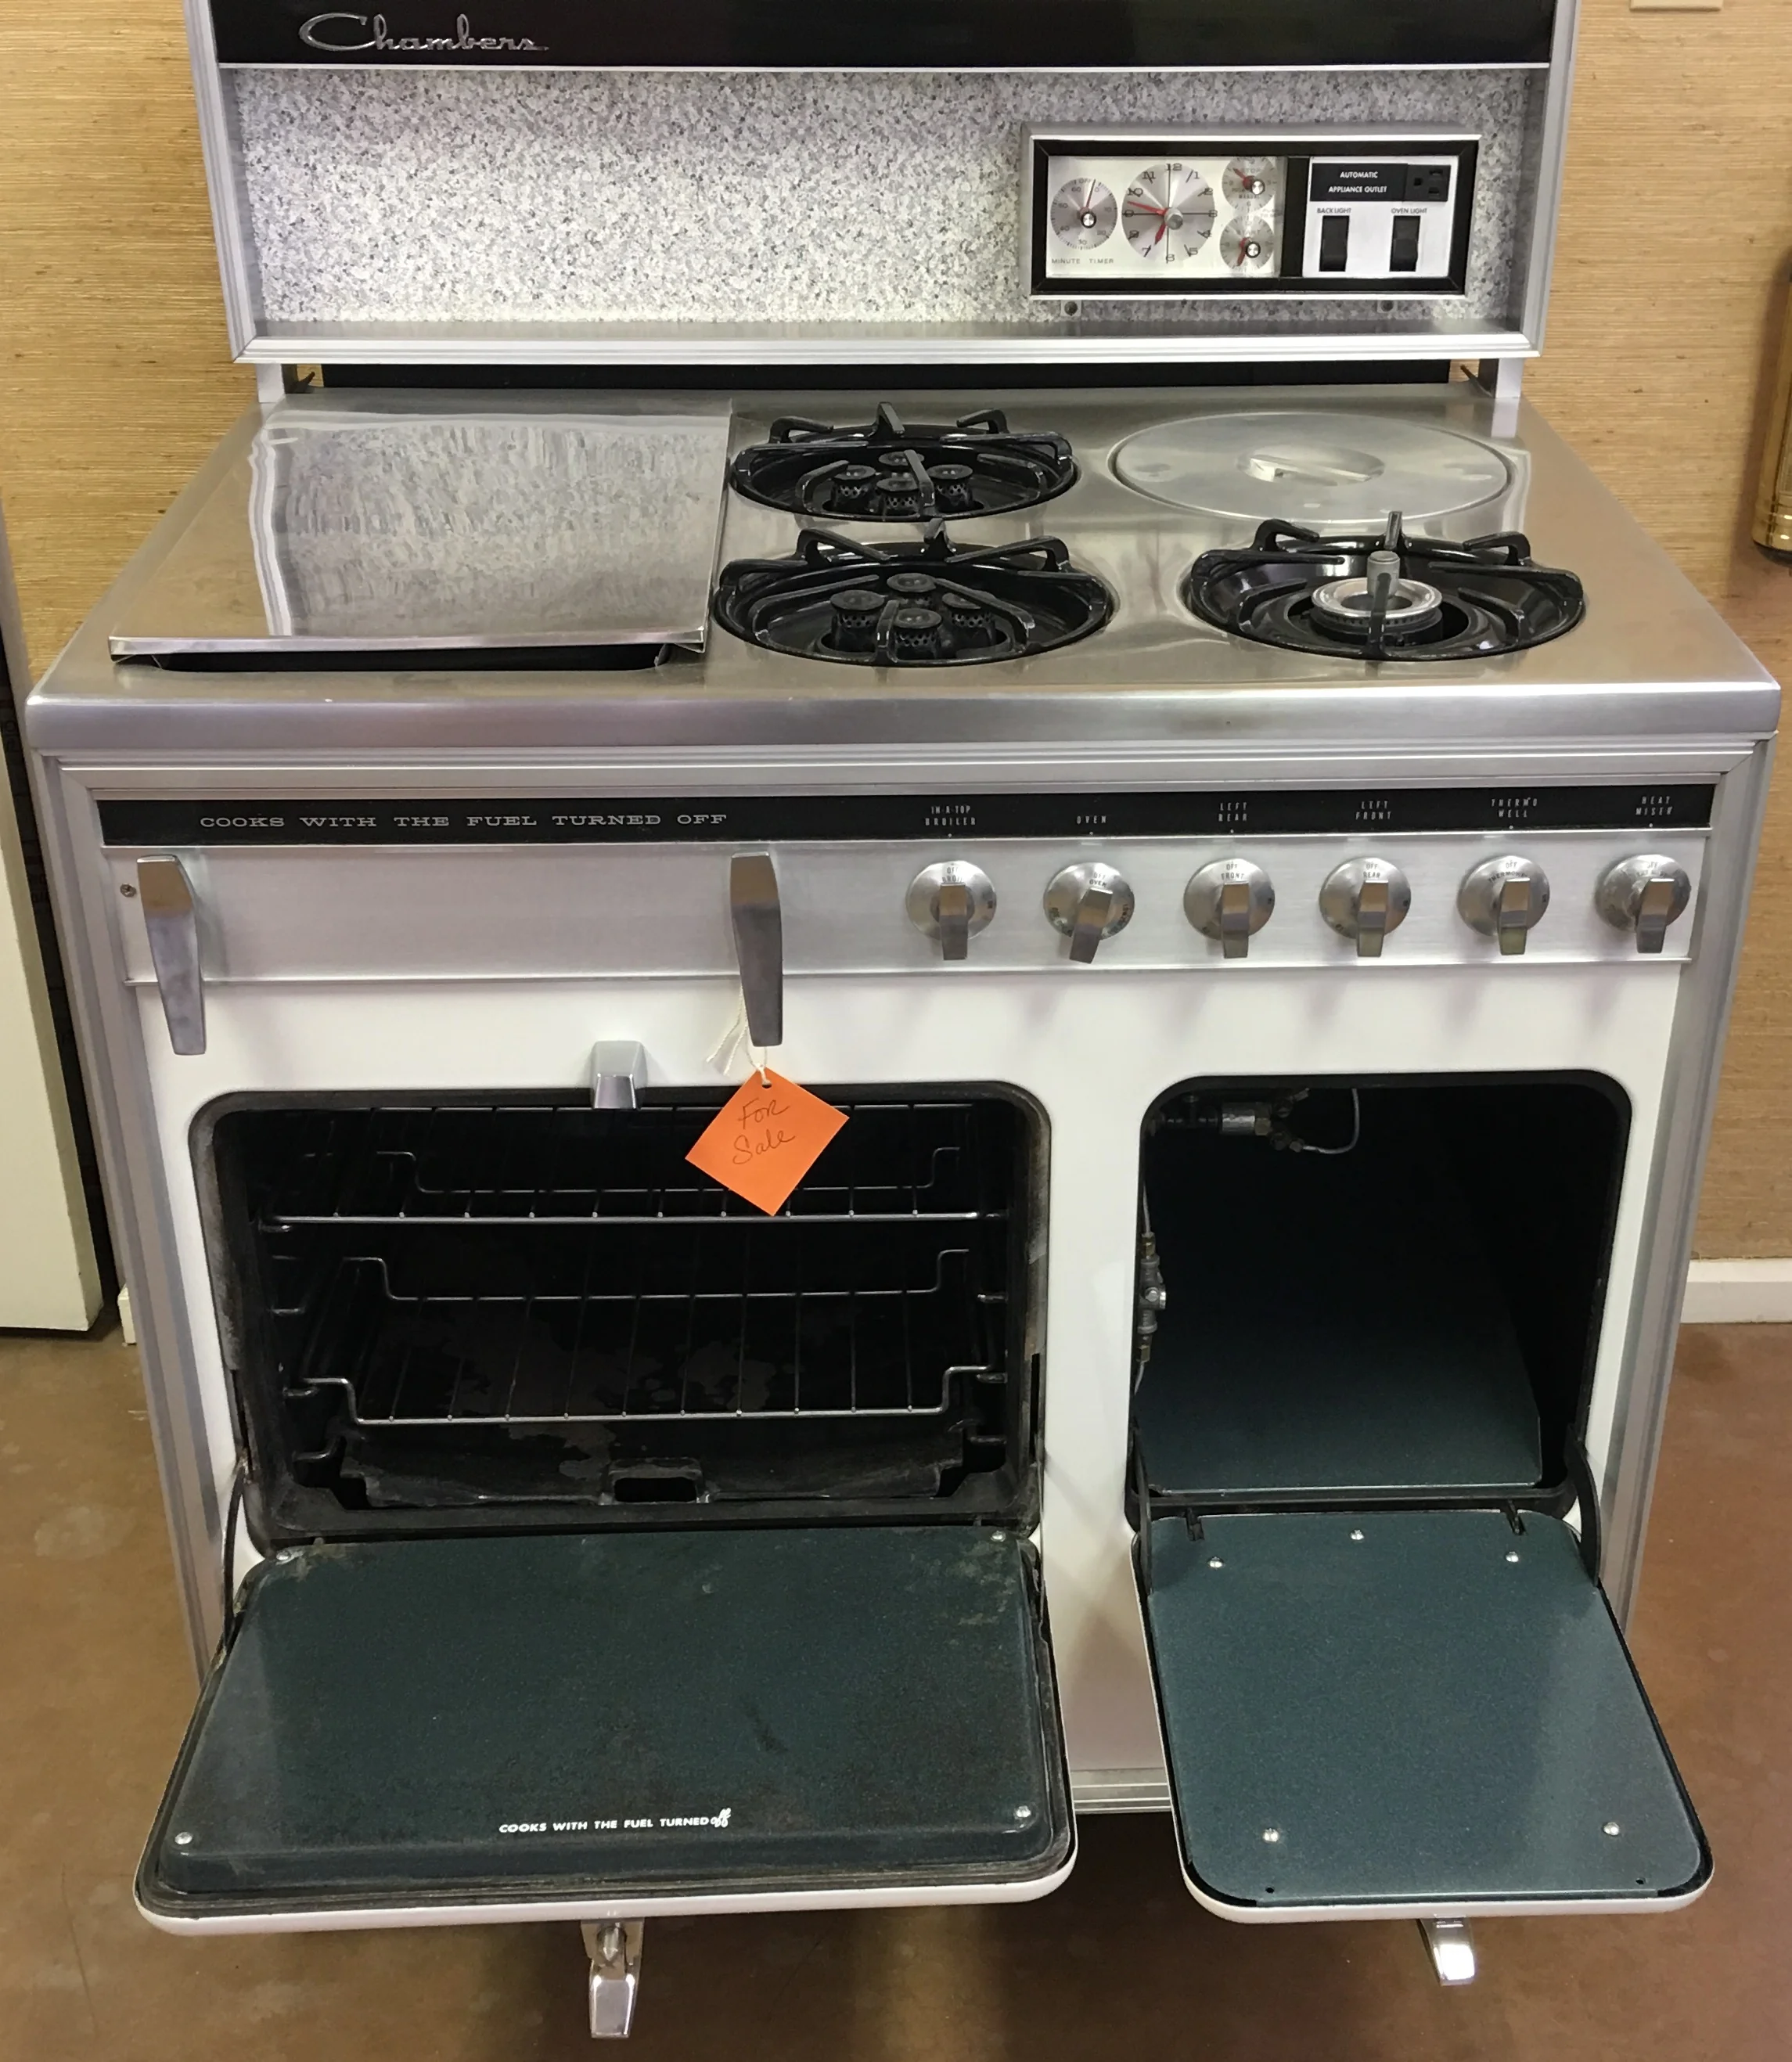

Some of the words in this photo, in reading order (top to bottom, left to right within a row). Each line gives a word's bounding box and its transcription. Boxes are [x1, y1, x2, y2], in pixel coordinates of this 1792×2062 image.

[298, 12, 549, 52] Chambers
[1165, 163, 1182, 171] 12
[1641, 796, 1670, 804] HEAT
[1219, 802, 1247, 811] LEFT
[1361, 801, 1388, 809] LEFT
[1355, 811, 1391, 820] FRONT
[1499, 809, 1528, 818] WELL
[1635, 806, 1673, 816] MISER
[200, 818, 285, 827] COOKS
[299, 817, 377, 827] WITH
[394, 816, 449, 826] THE
[466, 815, 537, 826] FUEL
[552, 815, 661, 826] TURNED
[677, 814, 727, 825] OFF
[925, 817, 976, 826] BROILER
[1077, 815, 1107, 824] OVEN
[1218, 813, 1247, 822] REAR
[1221, 872, 1245, 880] FRONT
[1089, 879, 1107, 887] OVEN
[732, 1128, 796, 1165] Sale
[498, 1823, 547, 1833] COOKS
[552, 1821, 588, 1831] WITH
[594, 1820, 617, 1830] THE
[624, 1819, 653, 1828] FUEL
[660, 1816, 709, 1827] TURNED
[710, 1808, 732, 1828] off
